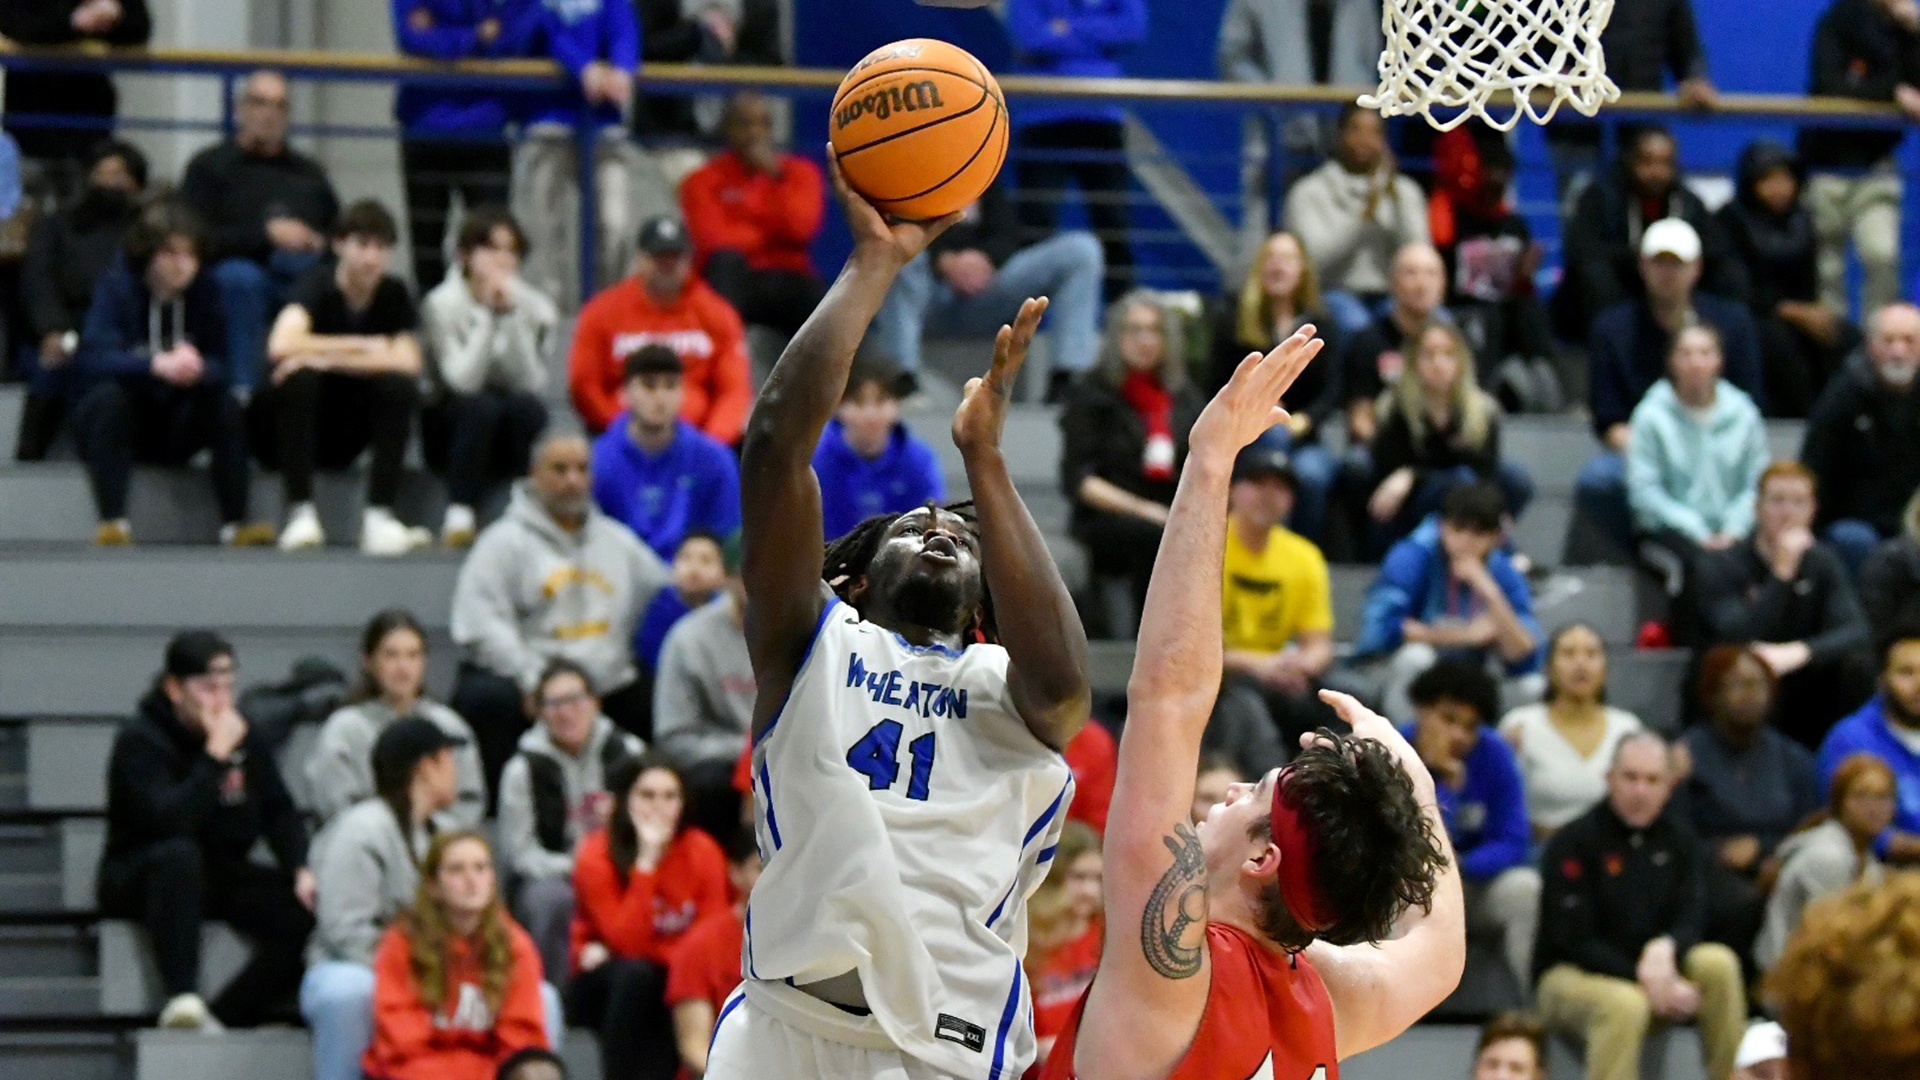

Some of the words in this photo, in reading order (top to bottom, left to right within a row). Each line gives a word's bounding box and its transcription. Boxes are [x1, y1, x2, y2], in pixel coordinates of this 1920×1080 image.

[837, 80, 944, 130] Wilson
[846, 652, 967, 719] WHEATON
[846, 718, 935, 801] 41
